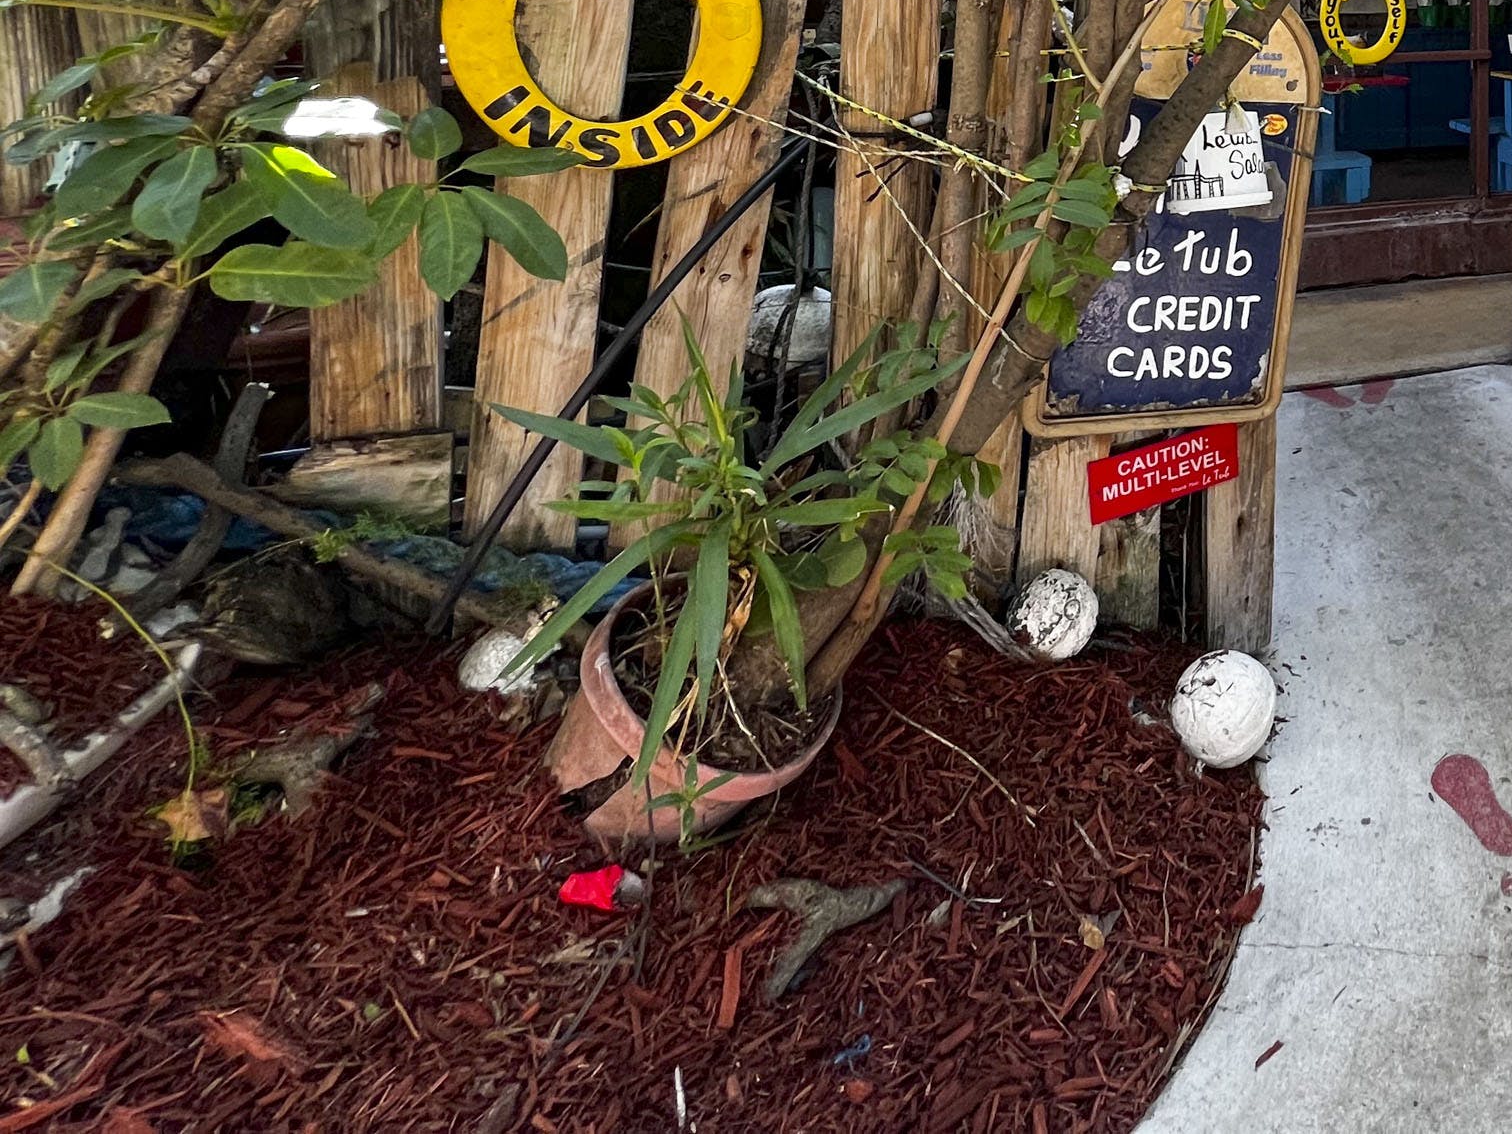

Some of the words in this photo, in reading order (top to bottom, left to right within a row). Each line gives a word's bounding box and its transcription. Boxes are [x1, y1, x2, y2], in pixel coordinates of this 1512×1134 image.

[483, 80, 730, 168] INSIDE
[1173, 227, 1253, 277] Tub
[1126, 295, 1261, 333] CREDIT
[1107, 345, 1233, 381] CARDS
[1102, 450, 1226, 502] MULTI-LEVEL
[1117, 436, 1210, 477] CAUTION:
